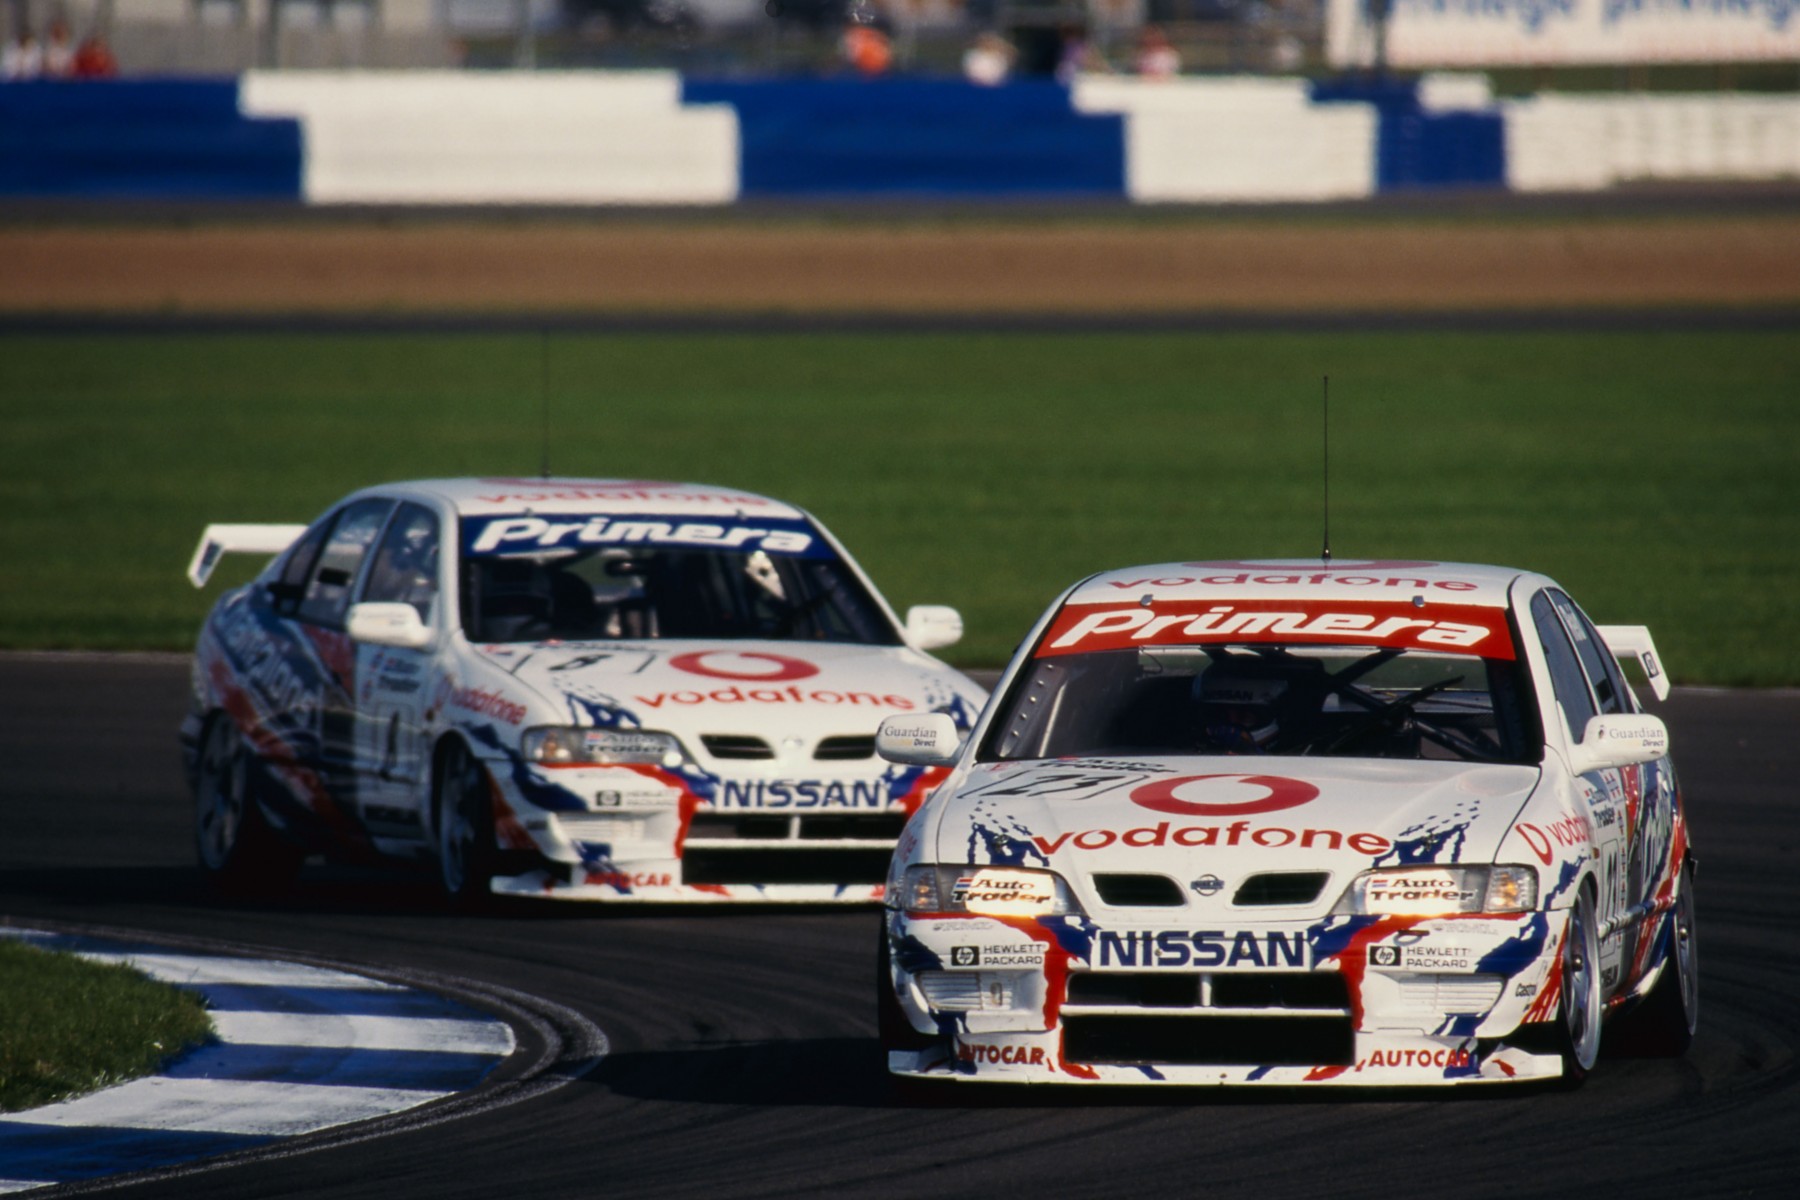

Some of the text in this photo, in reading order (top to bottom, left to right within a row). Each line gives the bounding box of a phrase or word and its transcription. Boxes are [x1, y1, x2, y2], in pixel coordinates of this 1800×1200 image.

[472, 517, 813, 552] Primera
[1107, 573, 1479, 591] vodafone
[1050, 606, 1491, 648] Primera
[632, 686, 916, 710] vodafone
[884, 726, 937, 738] Guardian
[1609, 728, 1664, 739] Guardian
[913, 738, 937, 747] Direct
[1642, 739, 1665, 748] Direct
[724, 779, 880, 808] NISSAN
[1030, 821, 1391, 855] vodafone
[971, 879, 1035, 890] Auto
[1391, 879, 1455, 887] Auto
[953, 890, 1051, 904] Trader
[1370, 889, 1475, 902] Trader
[984, 944, 1041, 953] HEWLETT
[1100, 931, 1304, 967] NISSAN
[1406, 947, 1467, 956] HEWLETT
[984, 956, 1043, 965] PACKARD
[1406, 958, 1468, 968] PACKARD
[1368, 1049, 1469, 1067] AUTOCAR
